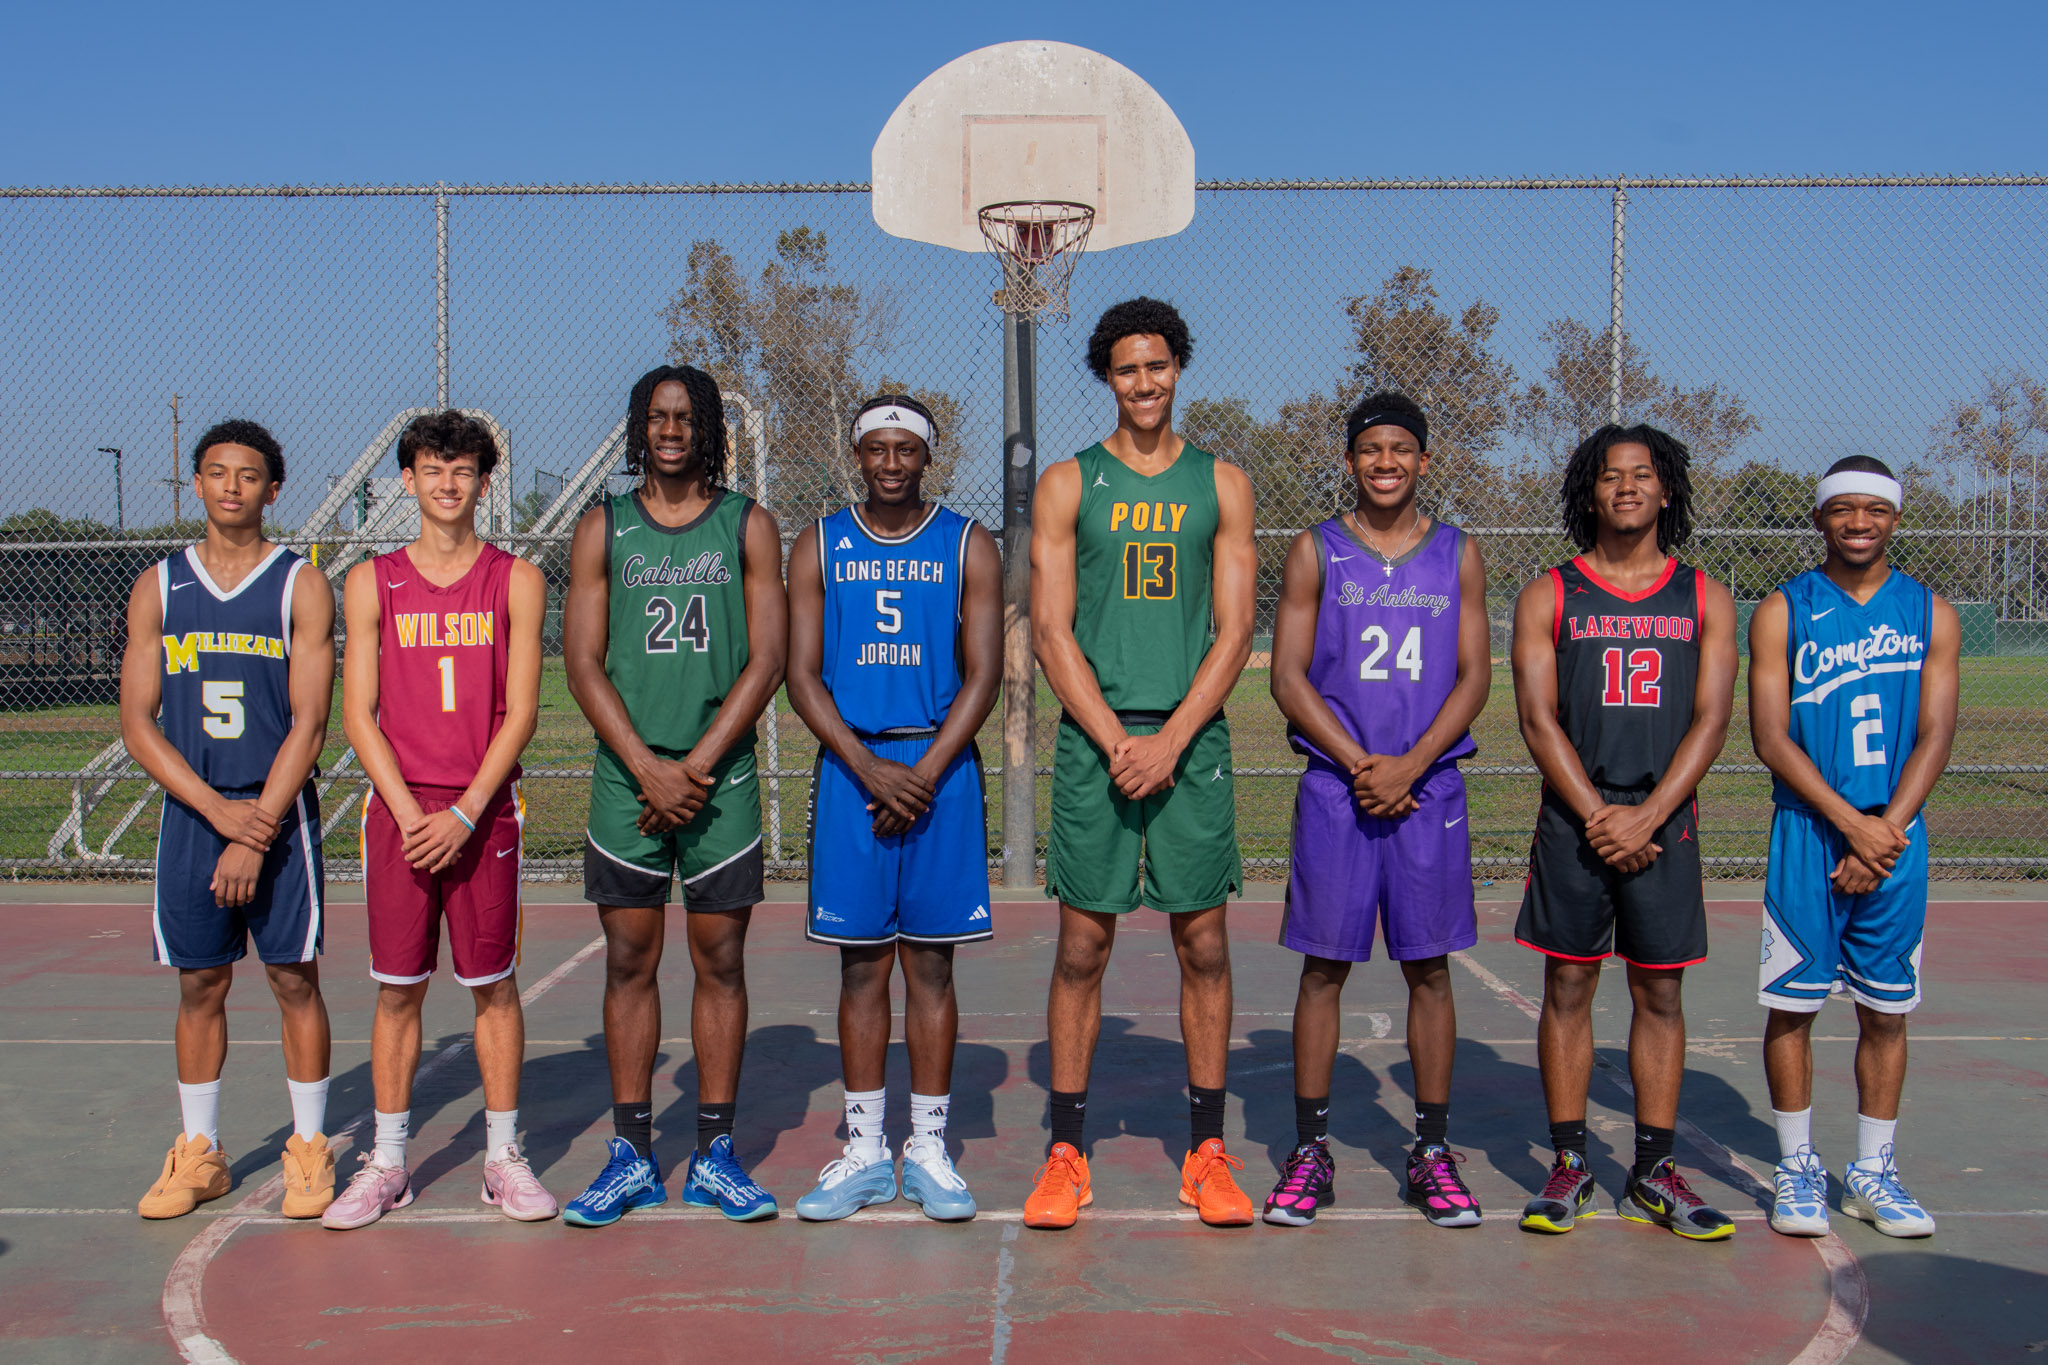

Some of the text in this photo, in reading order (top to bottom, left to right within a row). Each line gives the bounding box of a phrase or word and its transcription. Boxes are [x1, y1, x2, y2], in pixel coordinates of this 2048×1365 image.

[1109, 501, 1190, 533] POLY
[622, 551, 731, 588] Cabrillo
[834, 559, 944, 584] LONG BEACH
[1122, 542, 1176, 600] 13
[875, 589, 903, 635] 5
[1338, 581, 1450, 617] St Anthony
[395, 611, 494, 648] WILSON
[645, 594, 710, 654] 24
[1569, 615, 1694, 642] LAKEWOOD
[162, 632, 285, 675] MILLIKAN
[856, 642, 922, 666] JORDAN
[1360, 625, 1425, 683] 24
[1794, 624, 1924, 684] Compton
[437, 655, 456, 712] 1
[1602, 647, 1662, 708] 12
[202, 681, 245, 739] 5
[1850, 693, 1887, 767] 2
